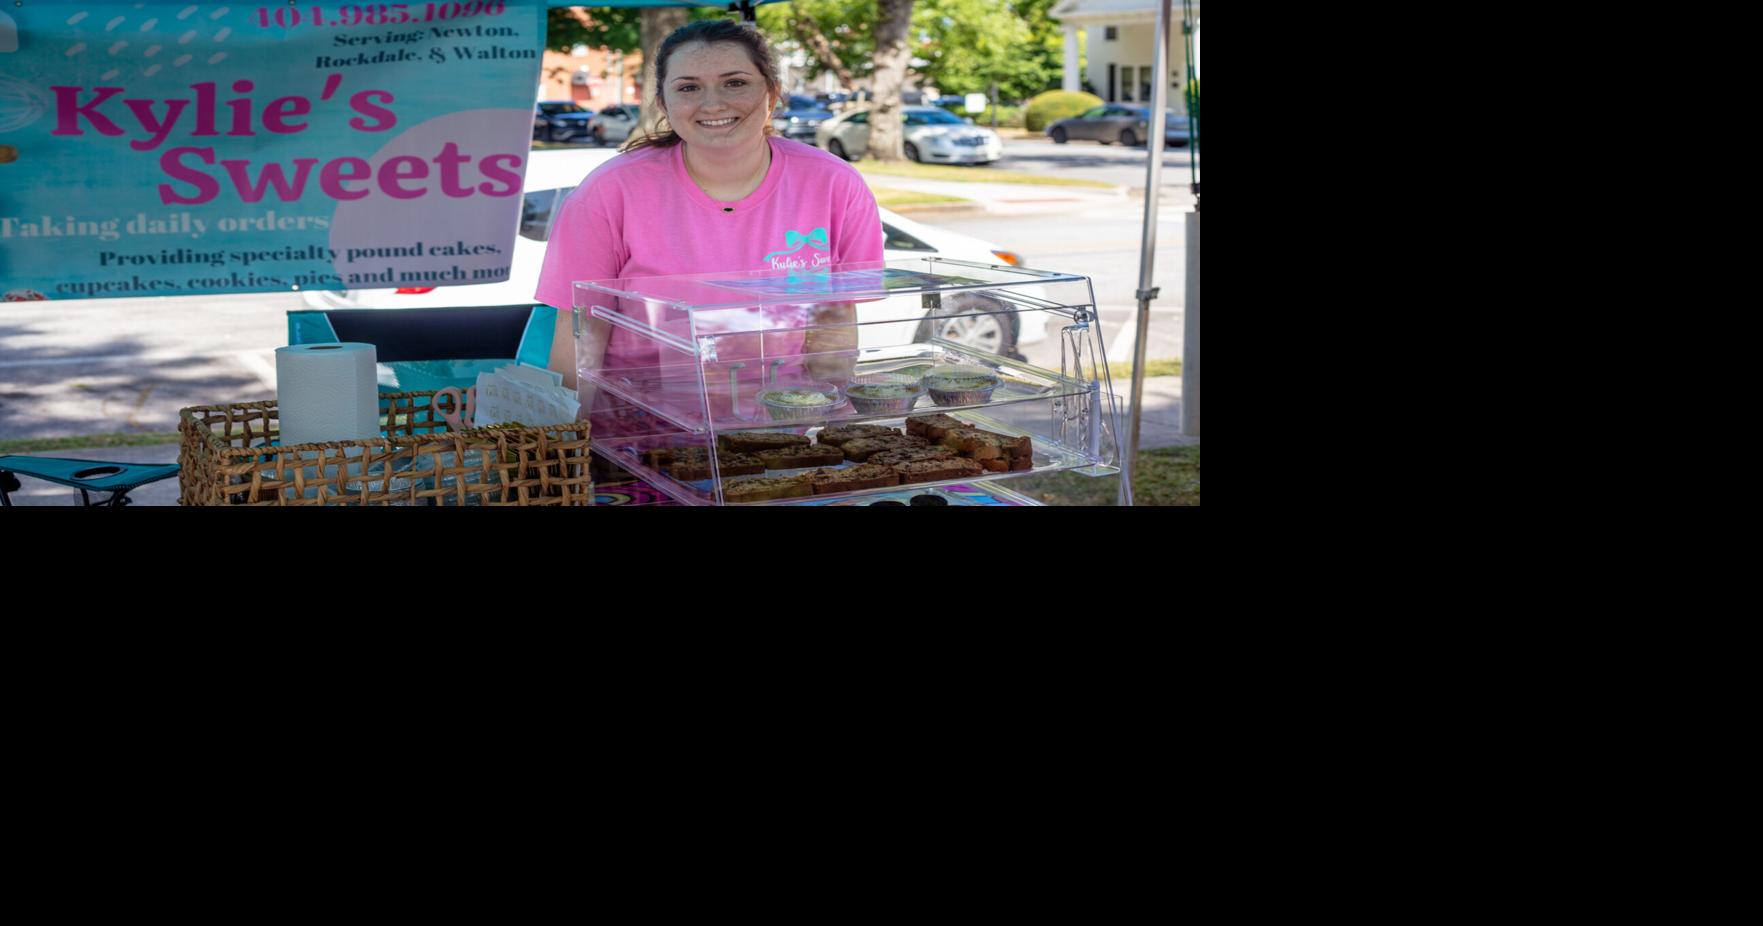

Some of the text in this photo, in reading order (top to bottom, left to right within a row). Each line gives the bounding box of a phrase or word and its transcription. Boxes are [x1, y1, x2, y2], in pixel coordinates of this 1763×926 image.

[333, 24, 519, 47] Serving: Newton,
[316, 46, 536, 69] Rockdale, & Walton
[49, 73, 398, 151] Kylie's
[158, 141, 522, 206] Sweets
[1, 211, 329, 241] Taking daily orders
[100, 240, 502, 267] Providing specialty pound cakes,
[55, 275, 181, 296] cupcakes,
[187, 270, 288, 289] cookies,
[294, 269, 341, 286] pies
[349, 267, 394, 284] and
[401, 264, 467, 282] much
